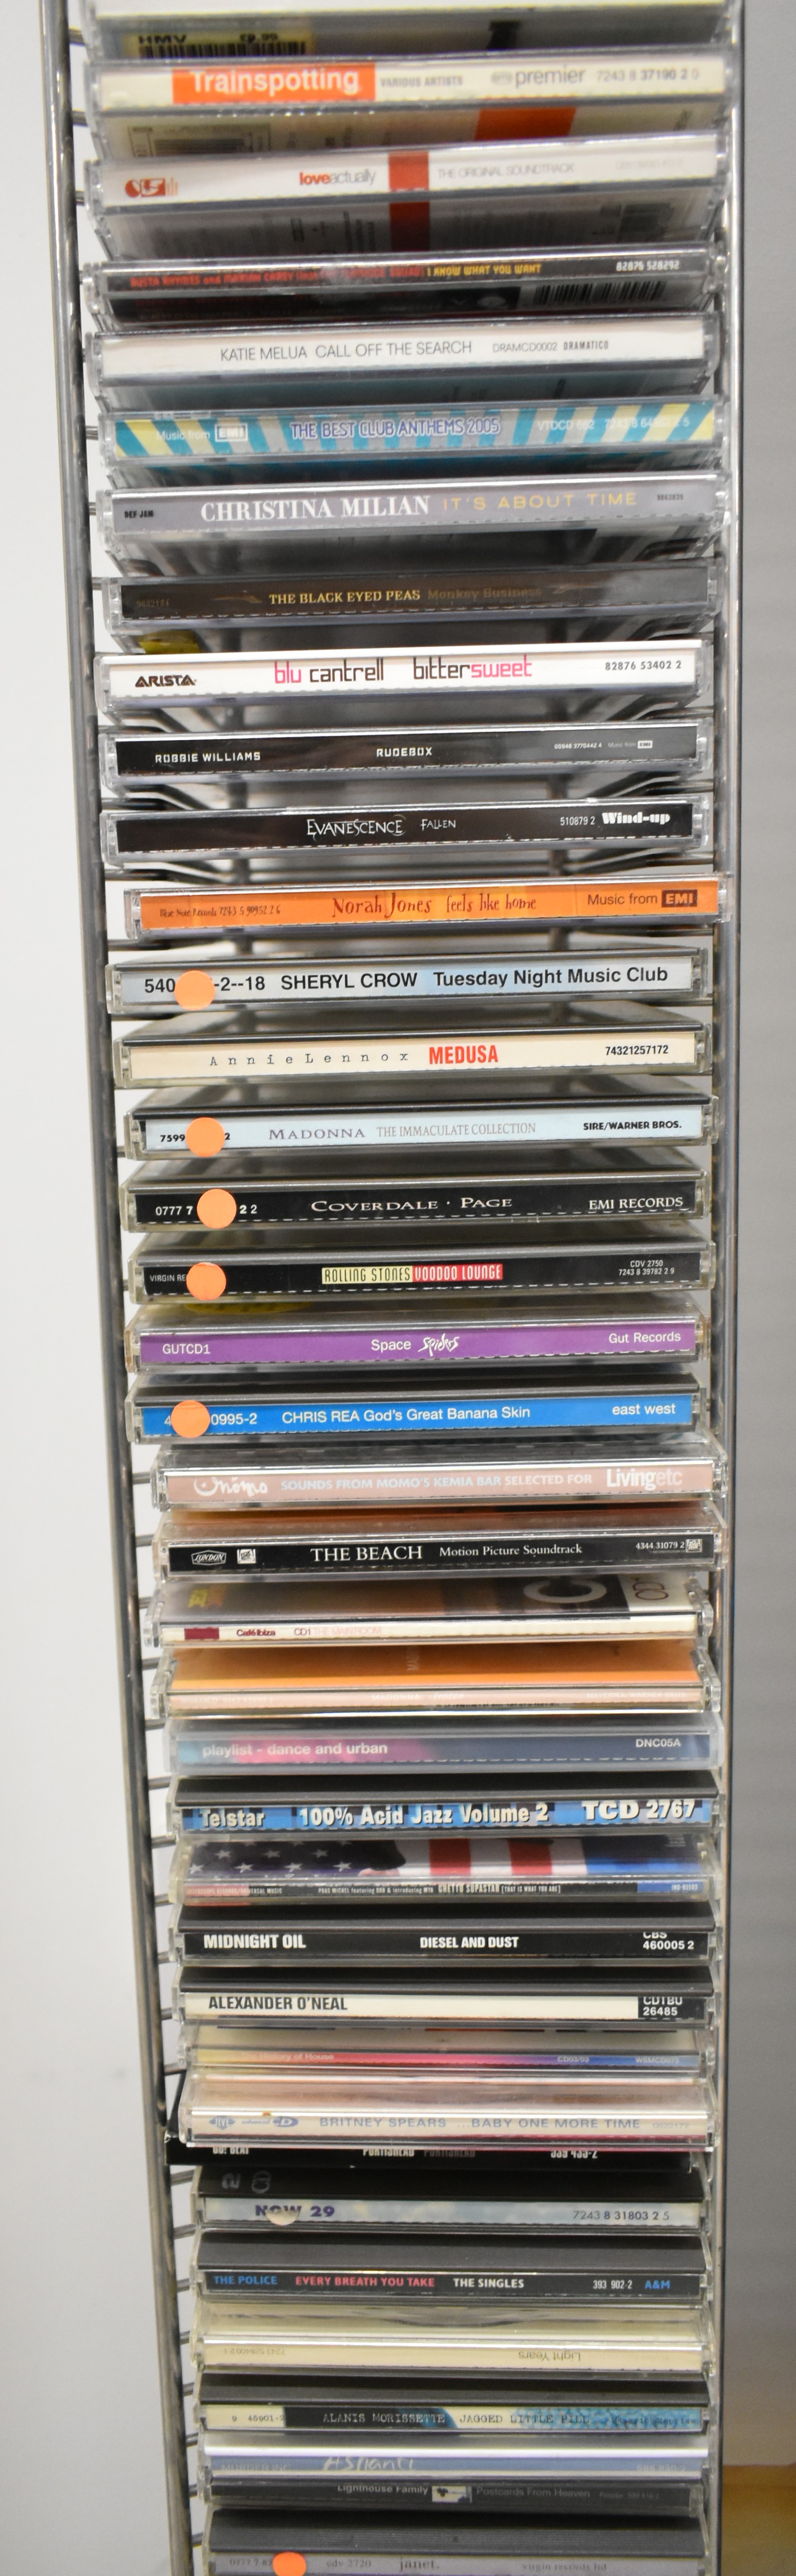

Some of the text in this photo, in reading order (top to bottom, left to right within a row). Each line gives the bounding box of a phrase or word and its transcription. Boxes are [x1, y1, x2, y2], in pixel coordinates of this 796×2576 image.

[190, 68, 358, 96] Trainspotting
[380, 76, 463, 87] VARIOUS ARTISTS
[515, 65, 585, 88] premier
[300, 168, 375, 185] loveactually
[433, 264, 541, 276] KNOW WHAT YOU WANT
[416, 341, 472, 355] SEARCH
[493, 340, 608, 352] DRAMCD0002 DRAMATICO
[221, 344, 382, 361] KATIE MELUA CALL OFF
[291, 417, 500, 439] THE BEST CLUB ANTHEMS 2005
[201, 492, 638, 522] CHRISTINA MILIAN IT'S ABOUT TIME
[269, 589, 420, 605] THE BLACK EYED PEAS
[275, 658, 384, 684] blu cantrell
[413, 654, 532, 680] bittersweet
[605, 661, 672, 671] 82876 53402
[135, 674, 196, 687] ARISTA
[155, 752, 261, 763] ROBBIE WILLIAMS
[377, 747, 433, 757] RUDEBOX
[560, 812, 670, 826] 510879 Wind-up
[307, 819, 457, 837] EVANESCENCE FALLEN
[333, 892, 536, 918] Norah Jones feels like home
[588, 892, 695, 906] Music from EMI
[281, 967, 669, 990] SHERYL CROW Tuesday Night Music Club
[430, 1045, 498, 1064] MEDUSA
[605, 1045, 669, 1056] 74321257172
[400, 1123, 536, 1137] IMMACULATE COLLECTION
[583, 1121, 682, 1131] SIRE/WARNER BROS.
[269, 1129, 365, 1140] MADONNA
[311, 1201, 438, 1212] COVERDALE
[461, 1197, 512, 1208] PAGE
[589, 1197, 683, 1210] EMI RECORDS
[324, 1265, 501, 1283] ROLLING STONES VOODOO LOUNGE
[608, 1332, 681, 1343] Gut Records
[163, 1344, 210, 1355] GUTCD1
[371, 1340, 411, 1353] Space
[282, 1406, 530, 1424] CHRIS REA God's Great Banana Skin
[613, 1403, 675, 1416] east west
[281, 1468, 682, 1491] SOUNDS FROM MOMO'S KEMIA BAR SELECTED FOR Livingetc
[193, 1553, 226, 1562] LONDON
[311, 1543, 582, 1561] THE BEACH Motion Picture Soundtrack
[294, 1628, 311, 1636] CD1
[346, 1743, 388, 1754] urban
[636, 1739, 681, 1748] DNC05A
[203, 1744, 311, 1757] playlist dance
[300, 1804, 530, 1826] 100% Acid Jazz Volume
[582, 1800, 695, 1820] TCD 2767
[201, 1809, 264, 1827] Telstar
[438, 1884, 463, 1894] GHETTO
[204, 1934, 306, 1949] MIDNIGHT OIL
[420, 1937, 459, 1948] DIESEL
[488, 1937, 519, 1947] DUST
[643, 1941, 685, 1950] 460005
[209, 1997, 348, 2010] ALEXANDER O'NEAL
[643, 2007, 678, 2016] 26485
[320, 2117, 446, 2127] BRITNEY SPEARS
[519, 2119, 640, 2129] ONE MORE TIME
[311, 2206, 335, 2217] 29
[573, 2211, 648, 2220] 7243 31803
[215, 2276, 434, 2287] THE POLICE EVERY BREATH YOU TAKE
[454, 2278, 524, 2289] THE SINGLES
[593, 2280, 670, 2290] 393 902-2 A&M
[518, 2351, 580, 2362] Light Years
[323, 2414, 590, 2424] ALANIS MORISSETTE JAGGED LITTLE PILL
